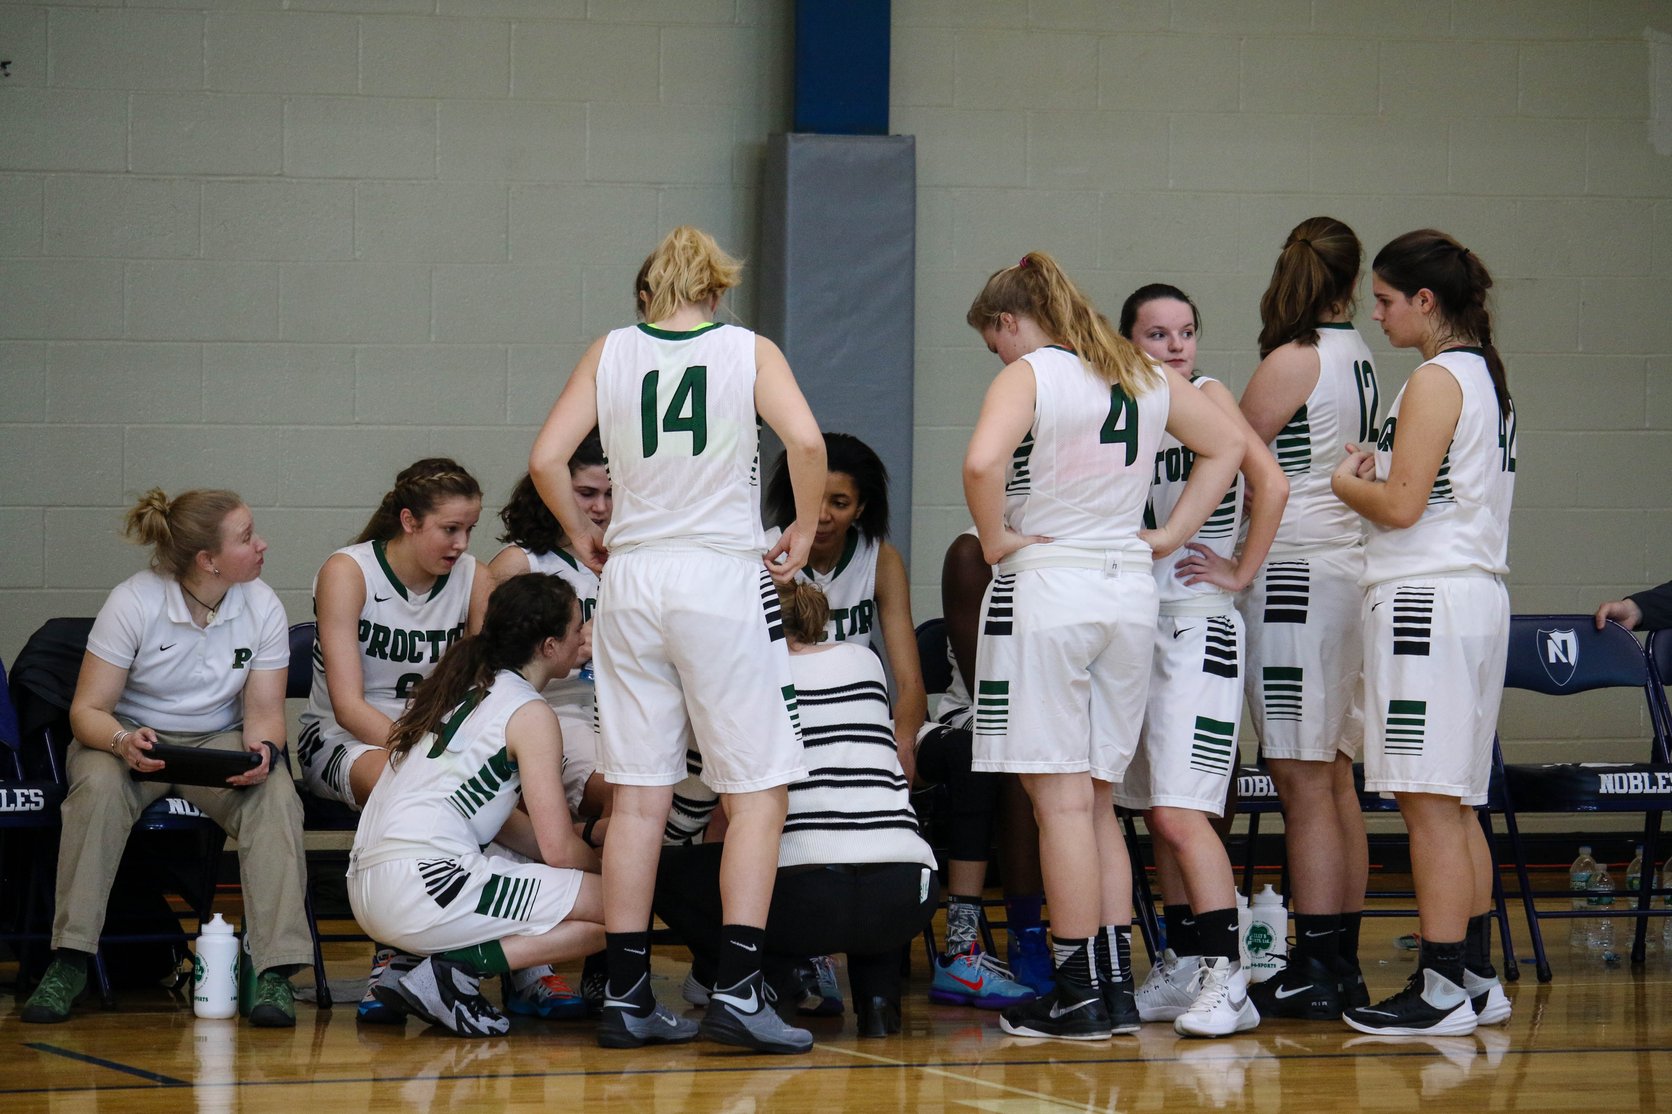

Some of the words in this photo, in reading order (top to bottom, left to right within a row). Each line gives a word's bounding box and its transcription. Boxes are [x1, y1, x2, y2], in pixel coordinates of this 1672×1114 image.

[641, 366, 707, 458] 14
[1100, 382, 1138, 467] 4
[1353, 360, 1379, 443] 12
[232, 648, 253, 669] P
[1547, 634, 1575, 665] N
[1598, 772, 1672, 794] NOBLE
